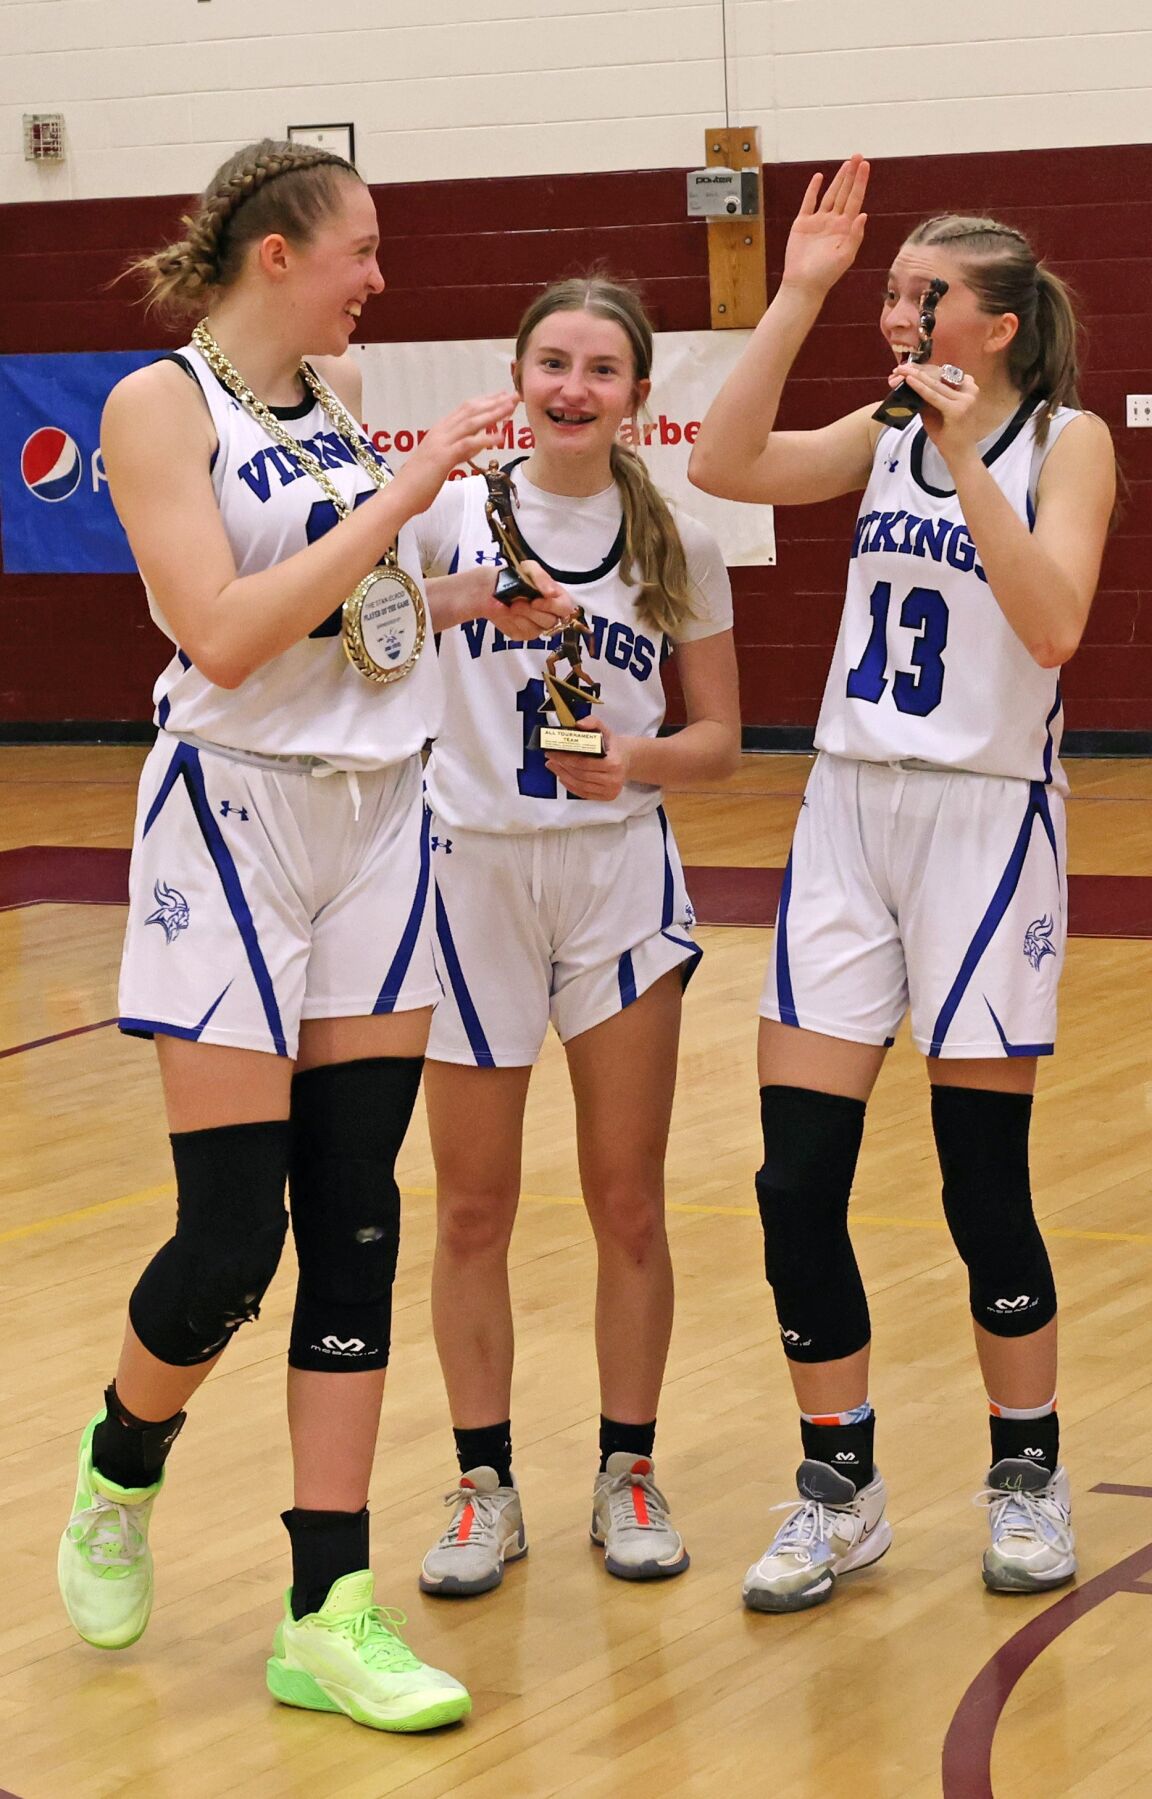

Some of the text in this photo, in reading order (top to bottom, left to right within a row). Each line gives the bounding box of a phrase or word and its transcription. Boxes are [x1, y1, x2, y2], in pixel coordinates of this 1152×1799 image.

[364, 609, 381, 620] PLAYER
[388, 604, 396, 613] THE
[397, 600, 409, 609] GAME
[846, 580, 949, 718] 13
[557, 731, 597, 739] TOURNAMENT
